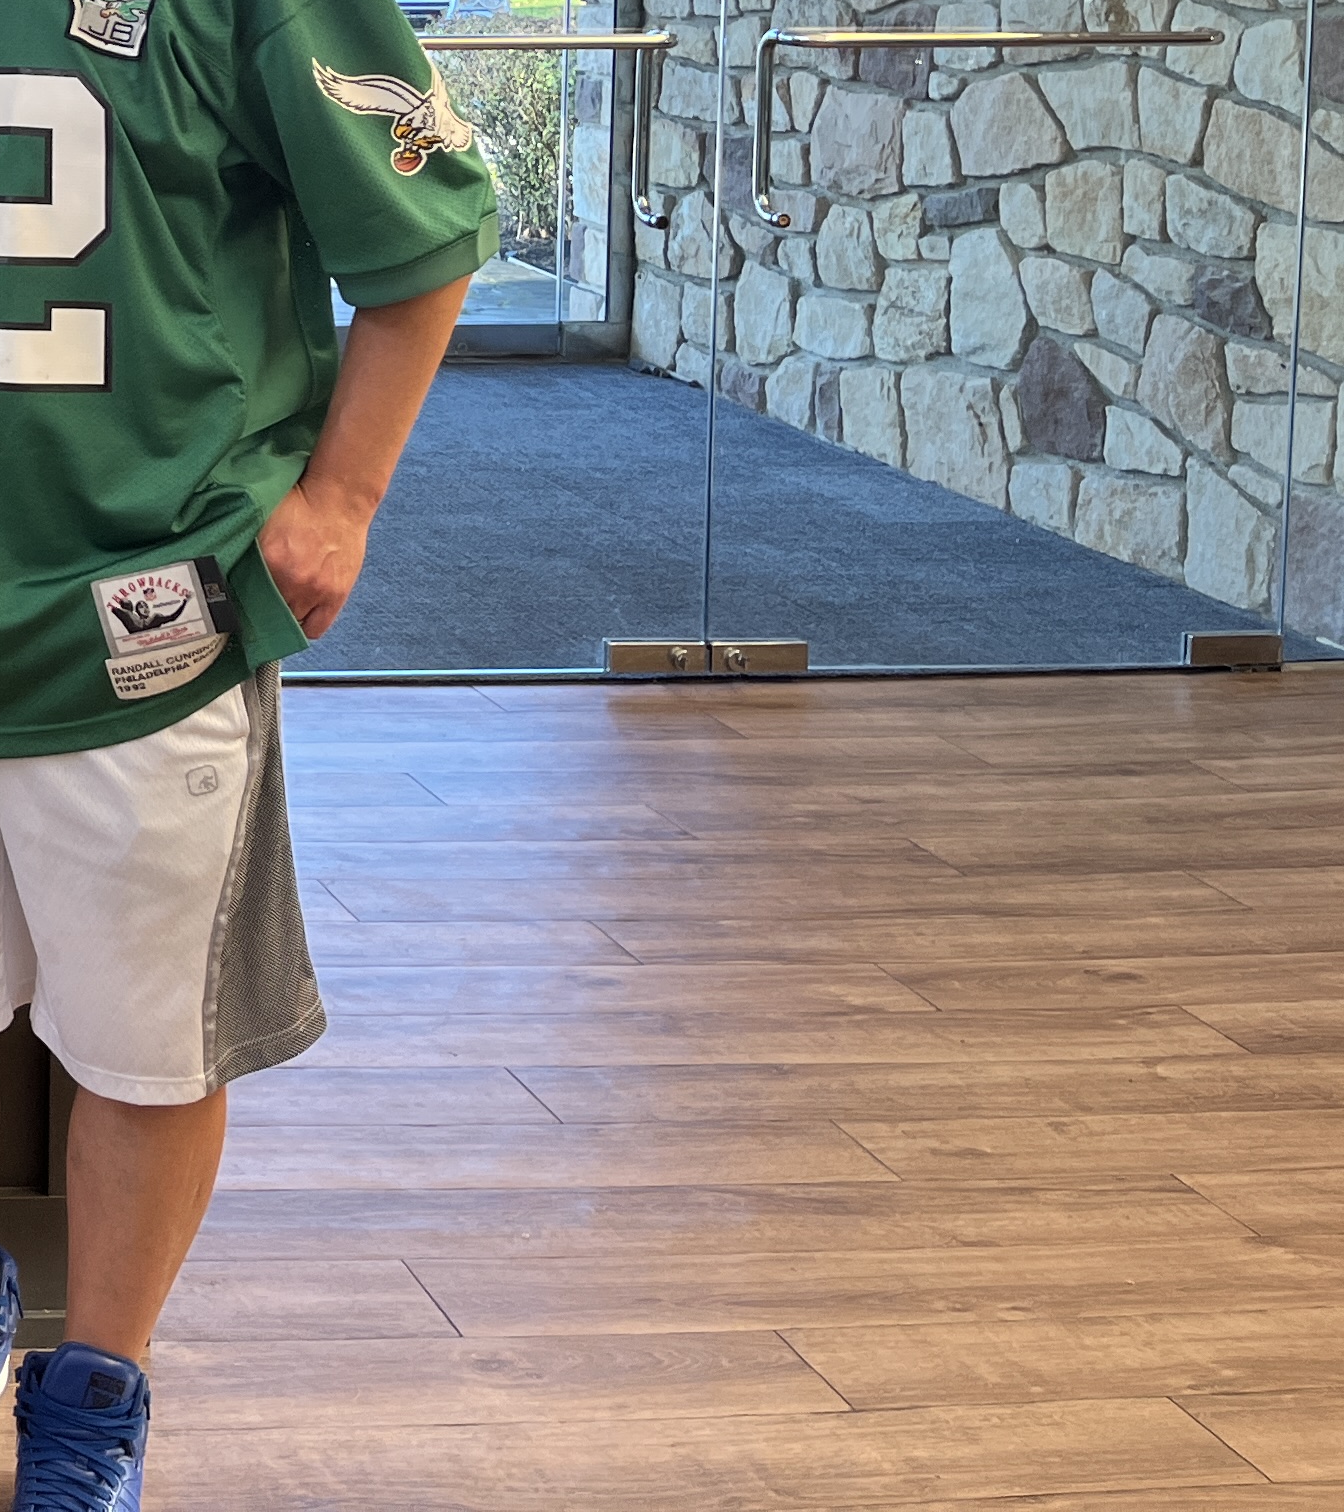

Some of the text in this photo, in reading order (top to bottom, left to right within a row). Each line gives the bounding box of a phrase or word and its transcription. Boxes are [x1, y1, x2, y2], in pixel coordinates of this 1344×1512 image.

[106, 576, 190, 610] THROWBACKS
[111, 659, 163, 676] RANDALL
[114, 662, 191, 684] PHILADELPHIA
